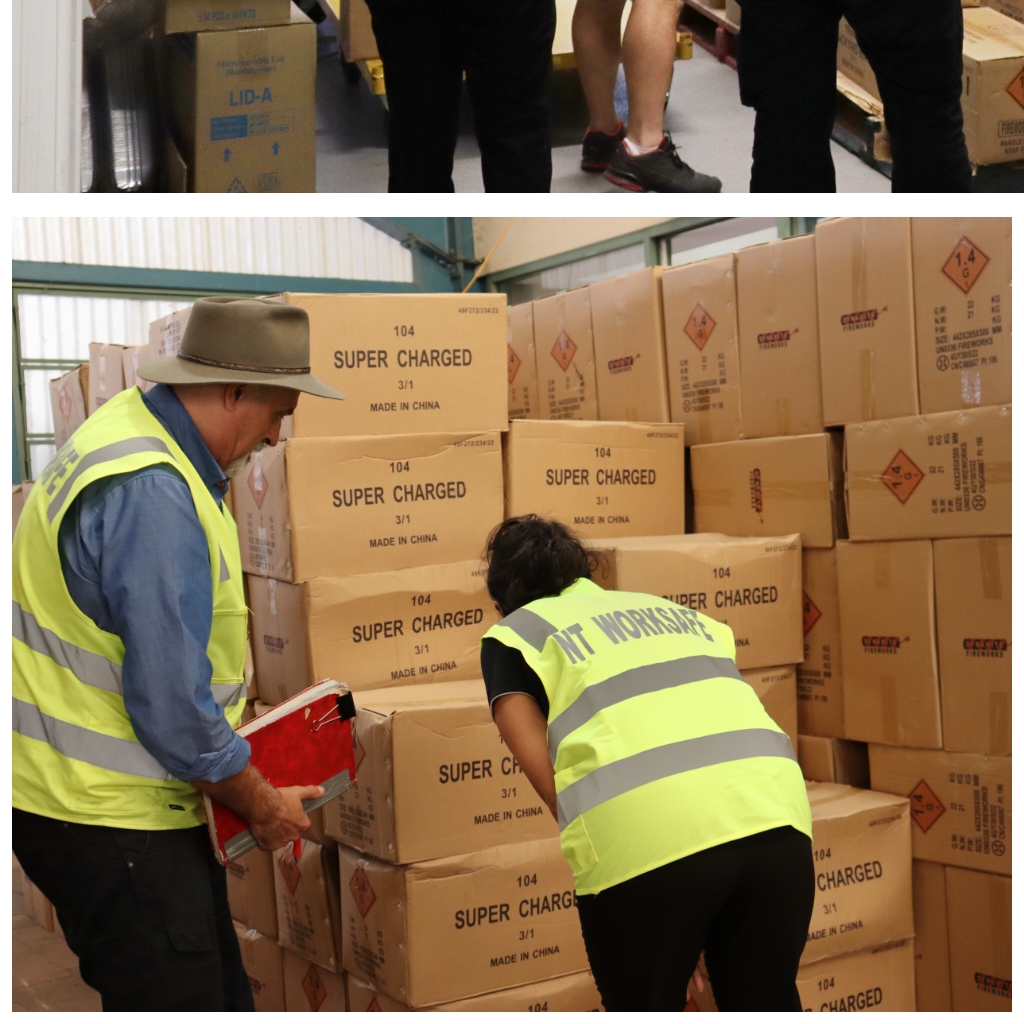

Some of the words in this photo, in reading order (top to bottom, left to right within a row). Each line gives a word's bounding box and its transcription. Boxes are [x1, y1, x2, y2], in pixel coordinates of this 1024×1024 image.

[229, 87, 273, 107] LID-A
[1000, 138, 1021, 147] HANDLE
[1004, 147, 1020, 155] KEEP
[955, 248, 976, 267] 1.4
[961, 268, 969, 278] G
[393, 325, 415, 337] 104
[958, 337, 993, 349] FIREWORKS
[333, 350, 388, 369] SUPER
[397, 349, 472, 367] CHARGED
[398, 380, 414, 390] 3/1
[370, 402, 397, 412] MADE
[400, 402, 410, 411] IN
[412, 401, 440, 411] CHINA
[594, 447, 611, 458] 104
[389, 461, 410, 473] 104
[960, 442, 969, 485] FIREWORKS
[546, 469, 589, 485] SUPER
[596, 468, 656, 485] CHARGED
[891, 465, 902, 489] 1.4
[332, 486, 385, 508] SUPER
[393, 481, 466, 503] CHARGED
[596, 496, 609, 506] 3/1
[395, 514, 411, 525] 3/1
[573, 516, 595, 525] MADE
[598, 516, 605, 524] IN
[607, 515, 630, 524] CHINA
[369, 538, 396, 548] MADE
[398, 536, 408, 546] IN
[410, 534, 438, 544] CHINA
[712, 567, 730, 578] 104
[411, 594, 431, 606] 104
[715, 586, 778, 608] CHARGED
[352, 620, 404, 643] SUPER
[412, 608, 484, 634] CHARGED
[552, 623, 595, 665] NT
[591, 606, 715, 645] WORKSAFE
[414, 644, 430, 655] 3/1
[391, 668, 416, 680] MADE
[419, 666, 428, 675] IN
[430, 661, 457, 673] CHINA
[439, 759, 493, 784] SUPER
[501, 787, 517, 799] 3/1
[474, 814, 501, 825] MADE
[503, 811, 513, 821] IN
[515, 806, 543, 820] CHINA
[814, 847, 831, 862] 104
[516, 874, 538, 888] 104
[817, 860, 883, 892] CHARGED
[454, 903, 510, 929] SUPER
[823, 903, 837, 915] 3/1
[518, 929, 535, 941] 3/1
[829, 927, 837, 937] IN
[839, 920, 863, 933] CHINA
[490, 953, 518, 968] MADE
[520, 952, 530, 962] IN
[532, 945, 560, 959] CHINA
[818, 978, 835, 992] 104
[820, 987, 883, 1012] CHARGED
